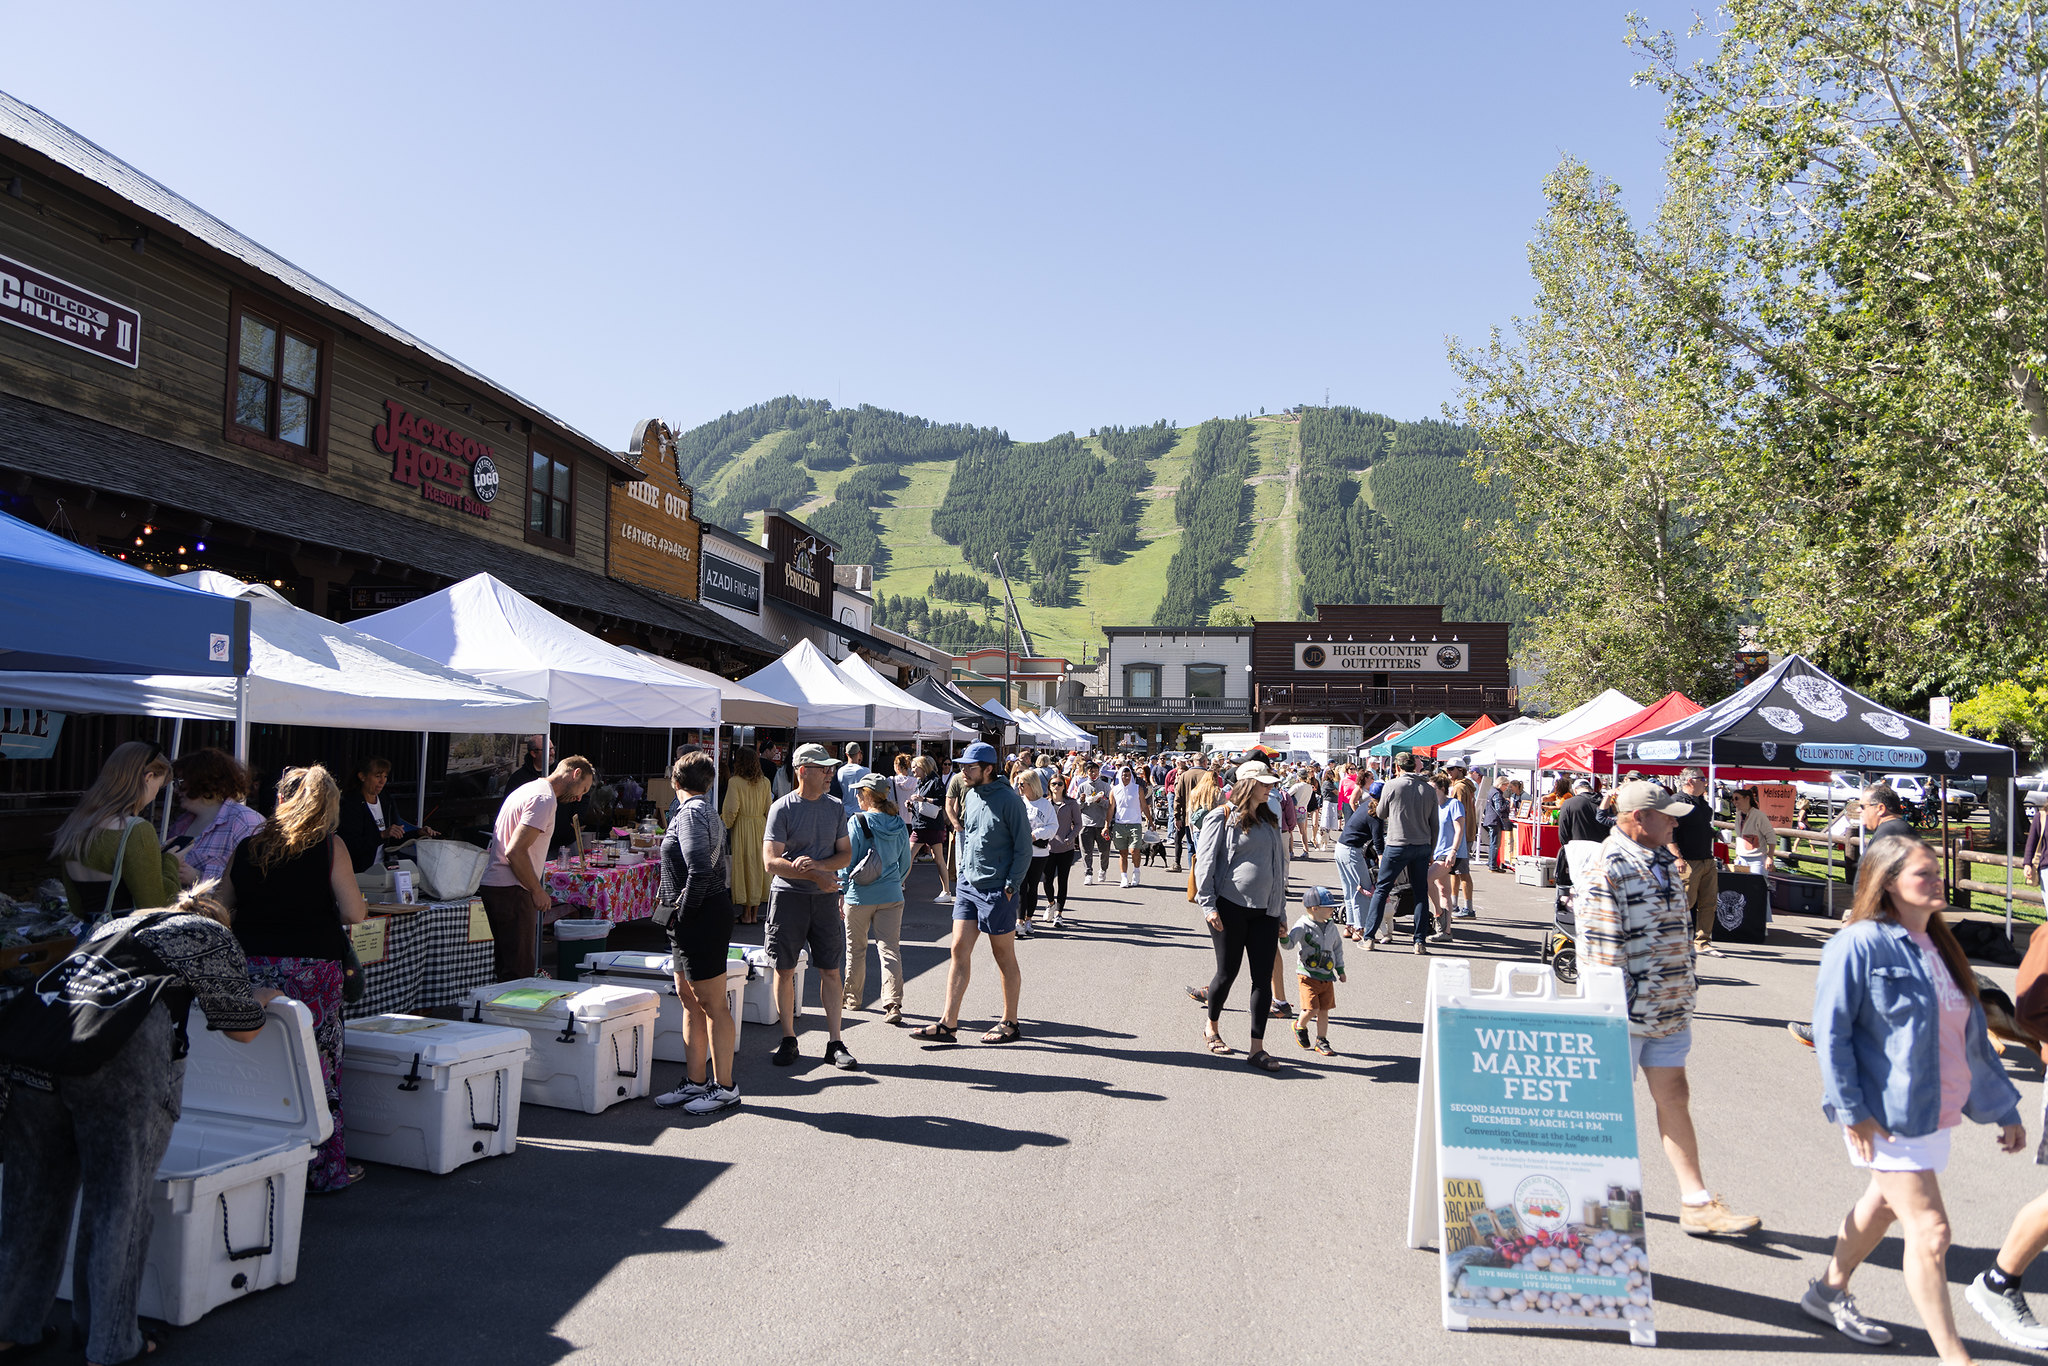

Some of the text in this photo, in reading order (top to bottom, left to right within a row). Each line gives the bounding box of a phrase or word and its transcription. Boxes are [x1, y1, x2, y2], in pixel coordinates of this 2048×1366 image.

[33, 285, 99, 322] WILCOX
[376, 399, 495, 462] JACKSON
[393, 440, 469, 489] HOLE
[473, 471, 499, 487] LOGO
[424, 481, 491, 519] Resort Store
[627, 480, 689, 521] HIDE OUT
[621, 523, 691, 561] LEATHER APPAREL
[705, 569, 759, 601] AZADI FINE ART
[785, 561, 821, 598] PENDLETON
[1332, 645, 1430, 657] HIGH COUNTRY
[1341, 658, 1421, 669] OUTFITTERS
[1797, 745, 1926, 765] YELLOWSTONE SPICE COMPANY
[1474, 1028, 1597, 1056] WINTER
[1472, 1051, 1601, 1080] MARKET
[1503, 1077, 1572, 1103] FEST
[1450, 1103, 1624, 1121] SECOND SATURDAY OF EACH MONTH
[1471, 1114, 1521, 1126] DECEMBER
[1529, 1118, 1568, 1129] MARCH:
[1570, 1121, 1583, 1129] 1-4
[1585, 1121, 1605, 1131] P.M.
[1464, 1127, 1511, 1138] Convention
[1512, 1129, 1539, 1139] Center
[1550, 1132, 1564, 1141] the
[1566, 1133, 1589, 1144] Lodge
[1591, 1135, 1599, 1143] of
[1600, 1135, 1612, 1144] JH
[1513, 1138, 1529, 1146] West
[1530, 1140, 1562, 1149] Broadway
[1478, 1269, 1496, 1278] LIVE
[1496, 1271, 1520, 1280] MUSIC
[1525, 1274, 1548, 1282] LOCAL
[1550, 1275, 1570, 1283] FOOD
[1576, 1277, 1617, 1287] ACTIVITIES
[1522, 1281, 1573, 1291] LIVE JUGGLER
